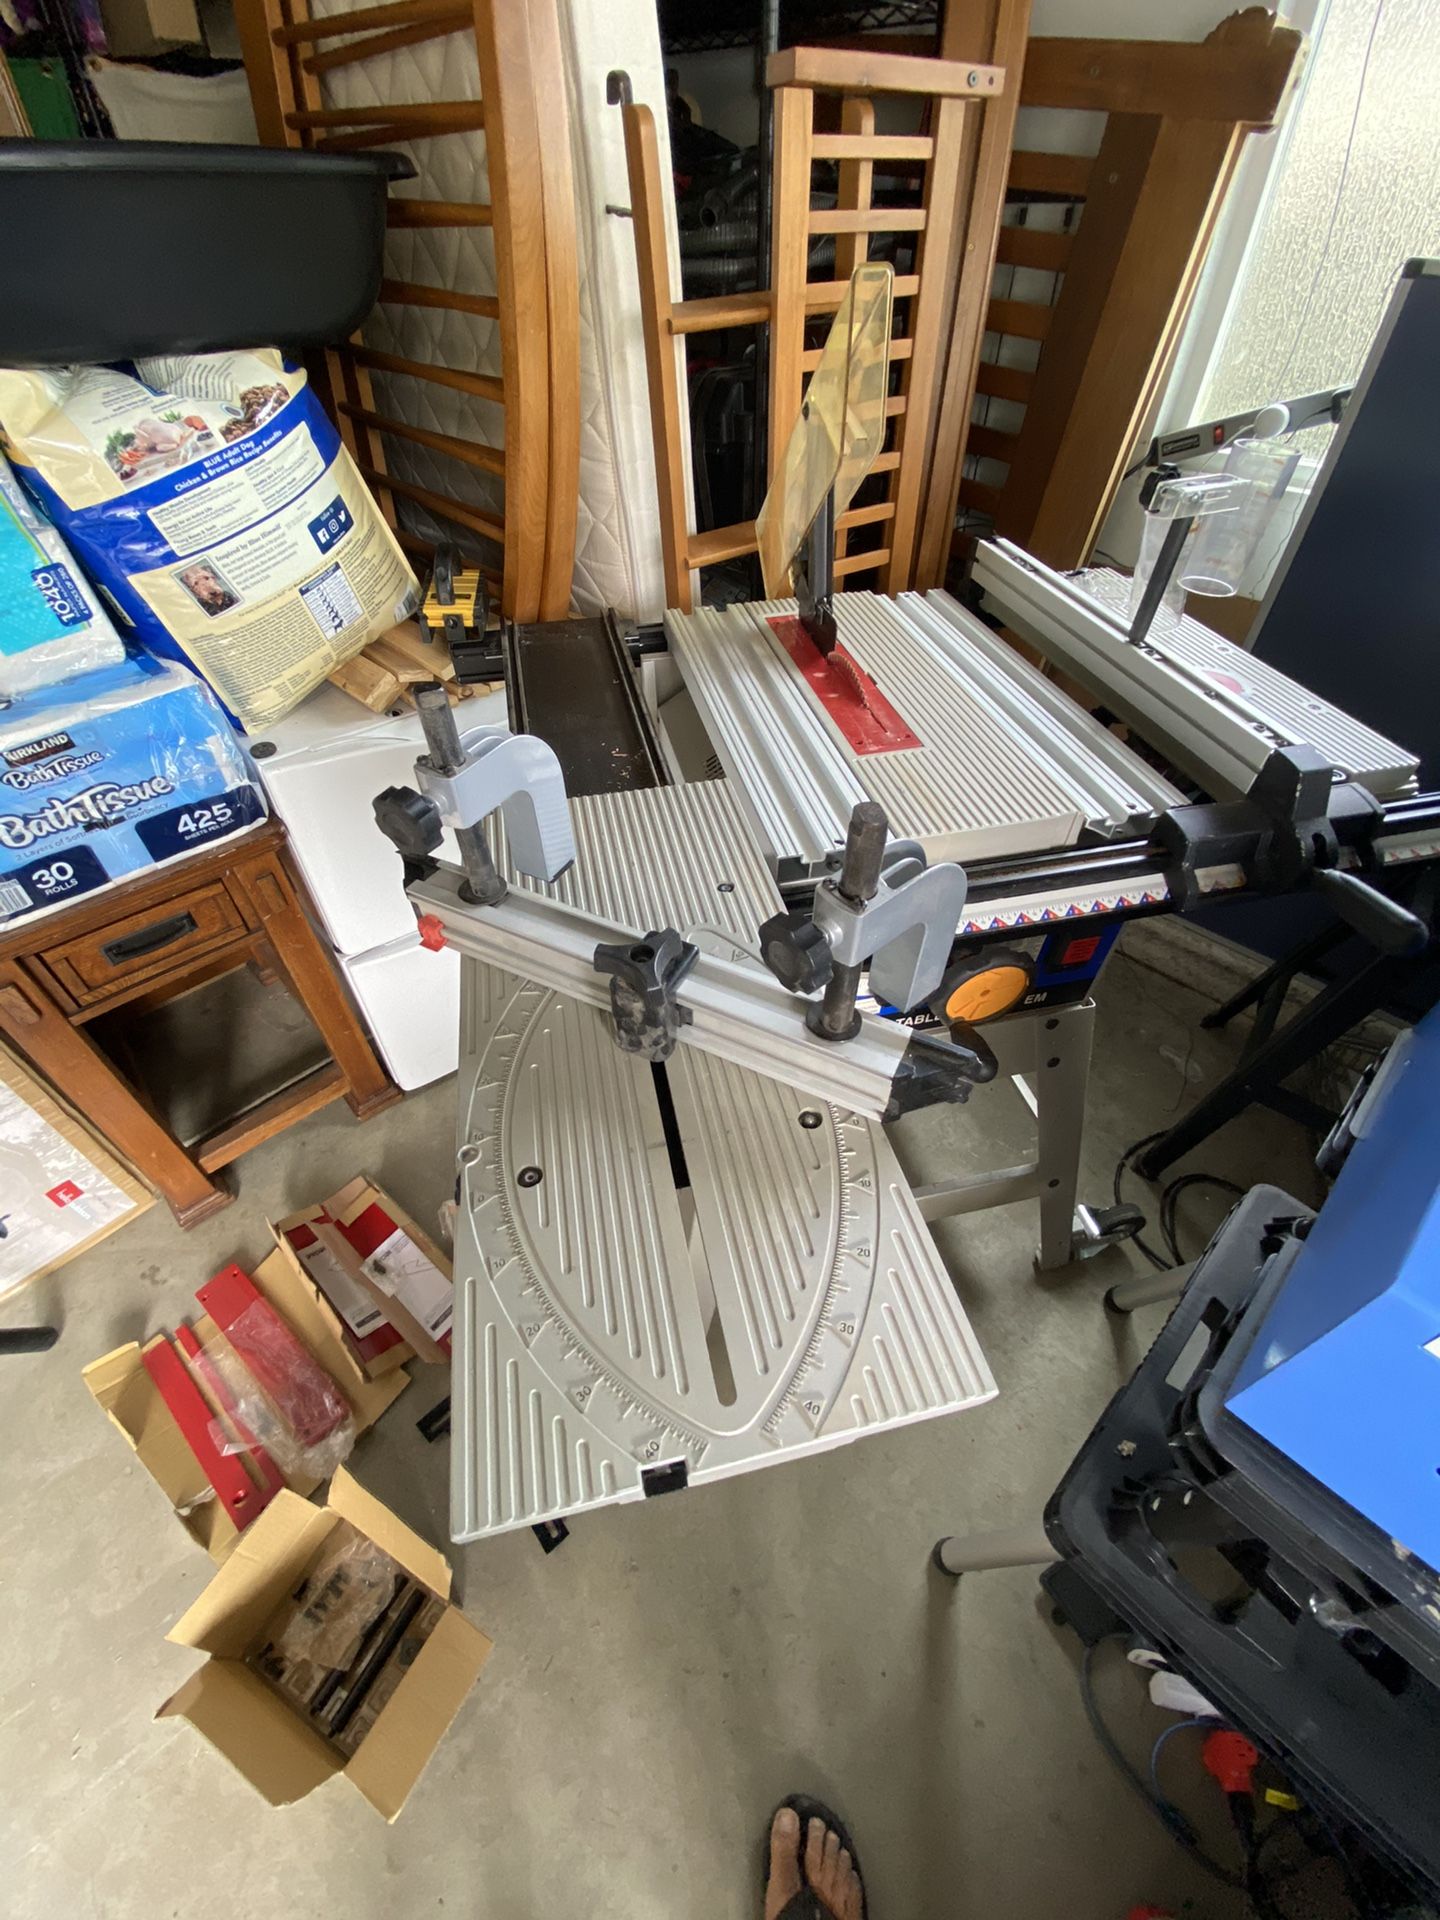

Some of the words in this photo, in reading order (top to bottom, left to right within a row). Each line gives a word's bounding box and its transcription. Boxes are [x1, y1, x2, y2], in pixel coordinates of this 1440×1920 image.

[174, 476, 201, 492] Chicken
[201, 472, 208, 480] &
[207, 462, 229, 476] Brown
[229, 456, 243, 466] Rice
[243, 446, 263, 459] Recipe
[262, 430, 282, 447] Benefits
[203, 456, 222, 468] BLUE
[223, 446, 241, 460] Adult
[241, 441, 255, 452] Dog
[214, 545, 240, 563] Inspired
[259, 523, 282, 539] Himself
[37, 573, 75, 622] 1040
[3, 734, 68, 760] KIRKLAND
[177, 803, 232, 833] 425
[184, 829, 208, 840] SHEETS
[208, 824, 220, 832] PER
[219, 818, 235, 828] ROLL
[23, 843, 54, 858] Layers
[55, 838, 65, 847] of
[32, 862, 74, 889] 30
[44, 878, 79, 896] ROLLS
[856, 1247, 870, 1258] 20
[494, 1258, 506, 1268] 10
[526, 1323, 541, 1337] 20
[839, 1322, 855, 1335] 30
[576, 1386, 592, 1402] 30
[804, 1401, 820, 1416] 40
[645, 1441, 660, 1459] 40
